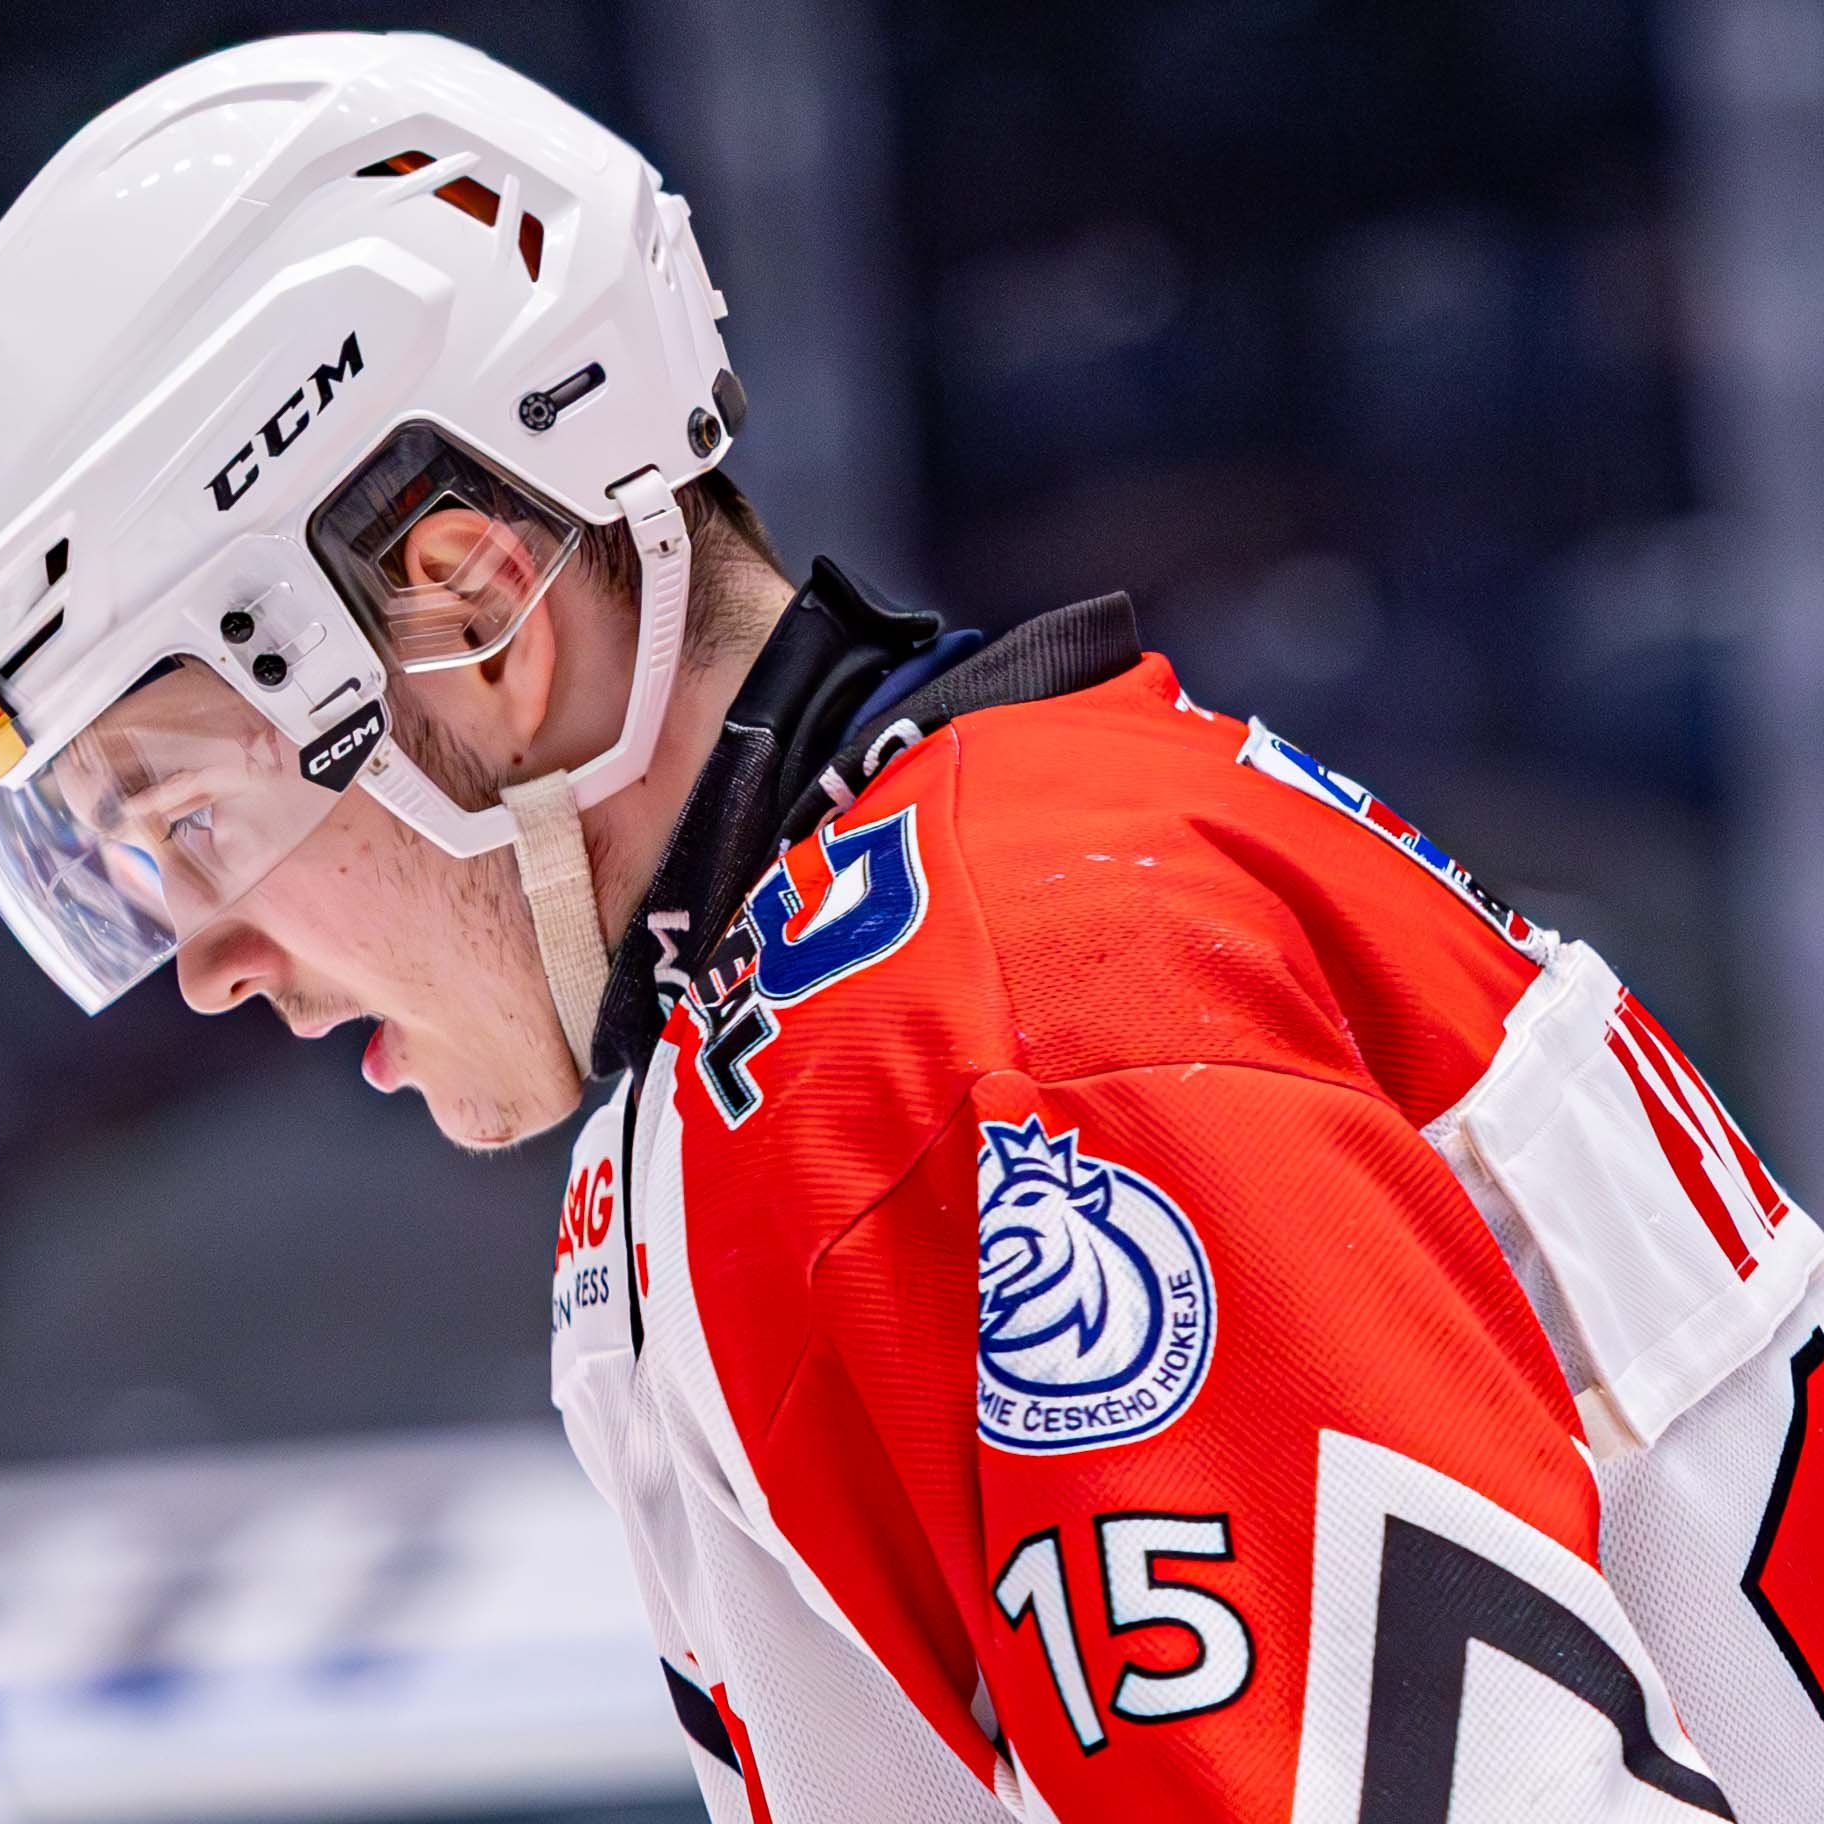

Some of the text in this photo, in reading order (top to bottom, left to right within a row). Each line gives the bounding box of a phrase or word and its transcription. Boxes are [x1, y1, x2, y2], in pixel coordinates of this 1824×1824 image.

[203, 330, 364, 512] CCM
[308, 715, 380, 776] CCM
[1022, 1396, 1159, 1432] ČESKÉHO
[1152, 1269, 1199, 1393] HOKEJE
[992, 1510, 1257, 1758] 15
